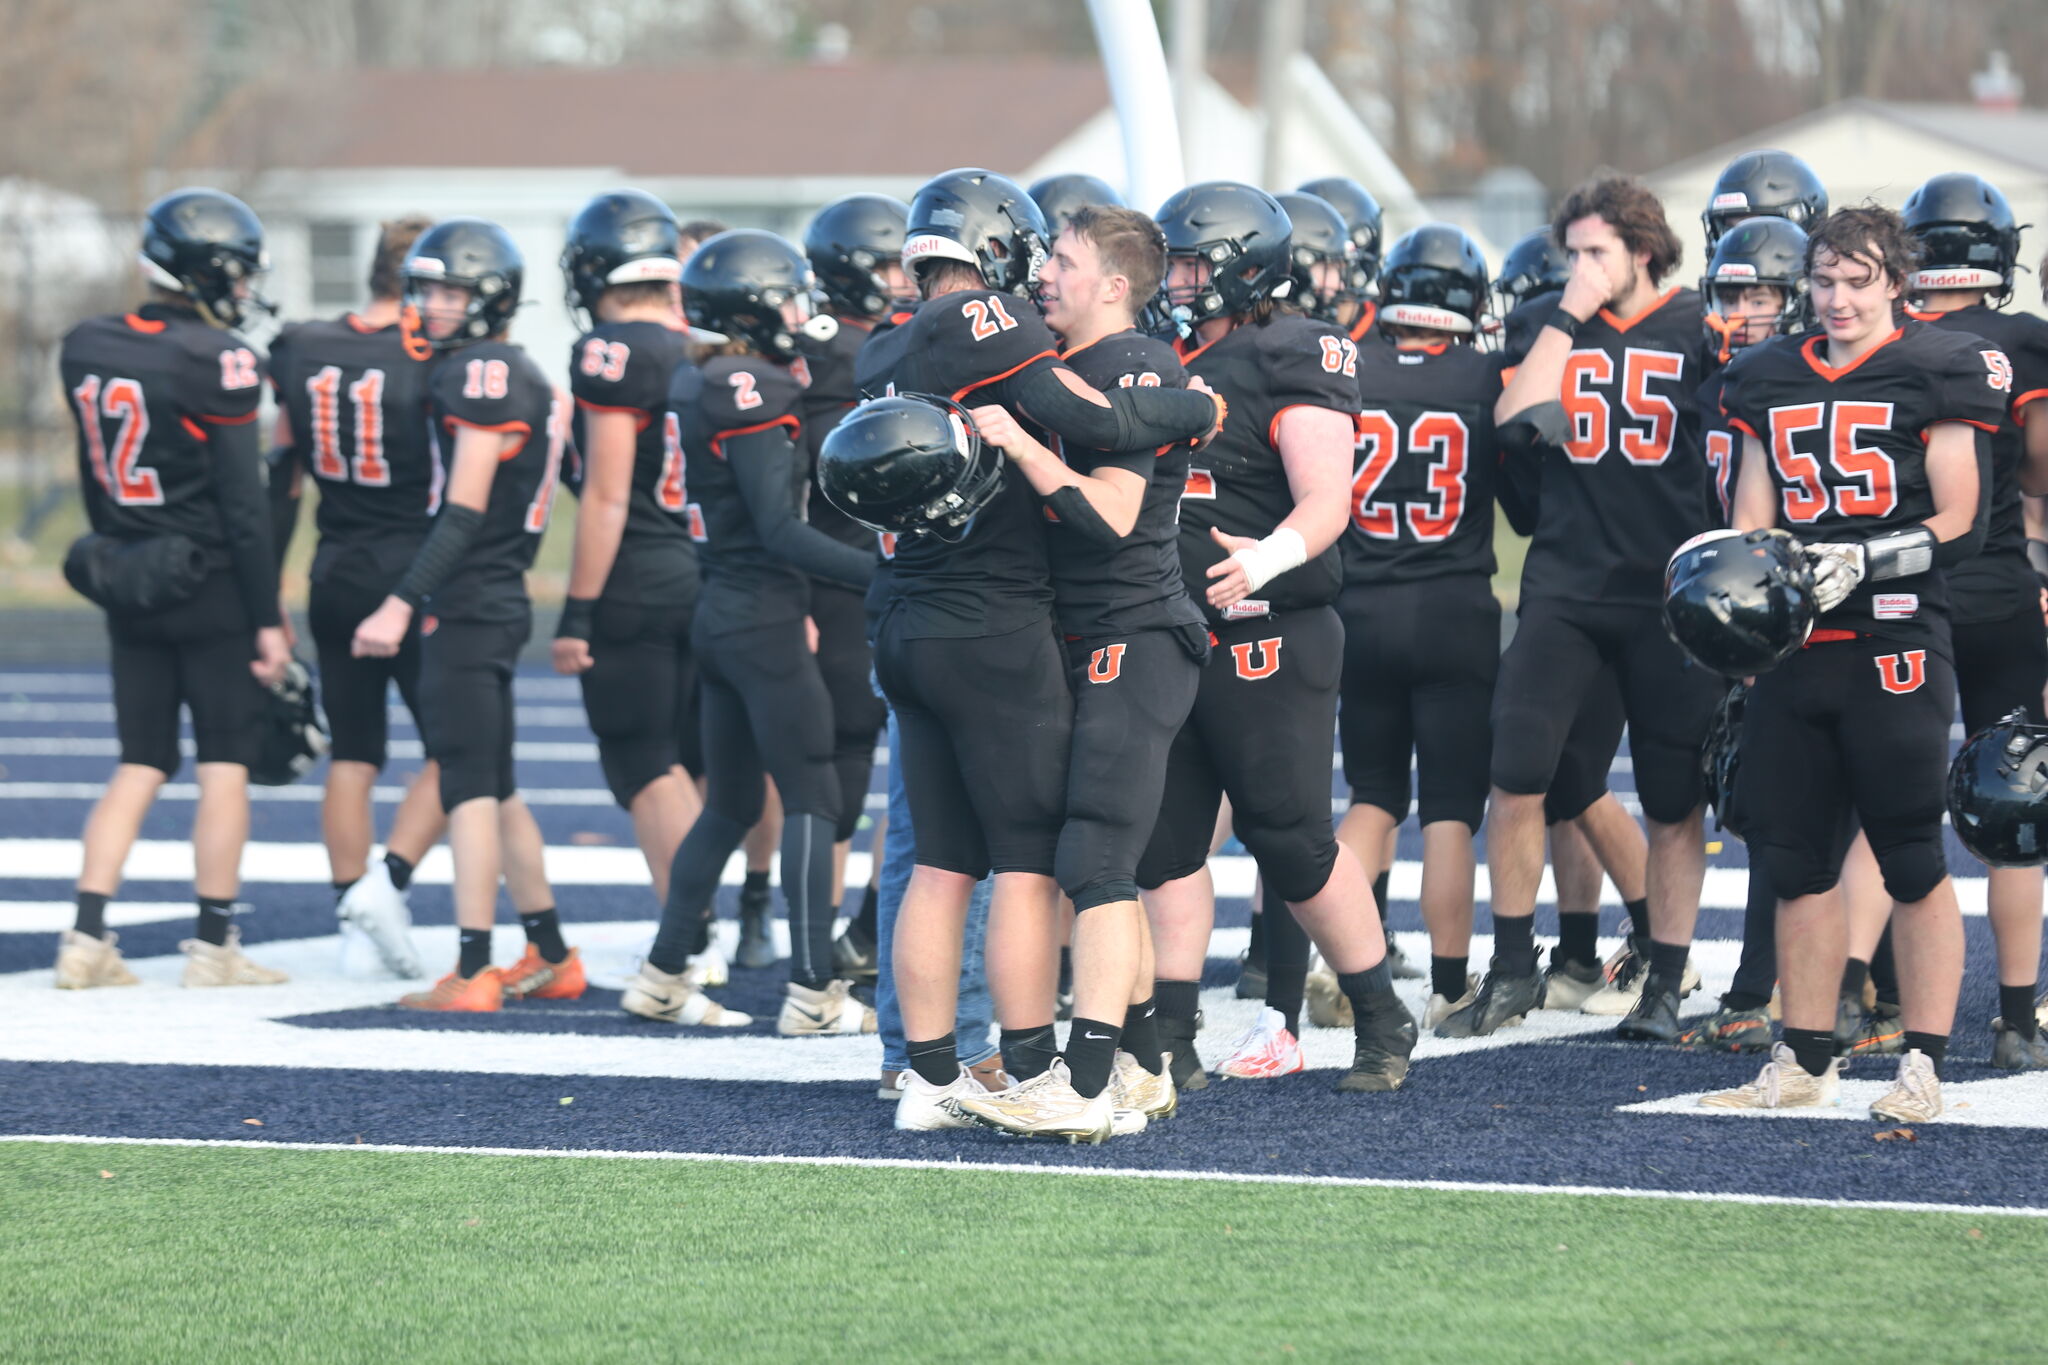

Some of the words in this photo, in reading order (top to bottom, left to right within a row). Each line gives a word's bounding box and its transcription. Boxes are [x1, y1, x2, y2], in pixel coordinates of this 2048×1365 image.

[1918, 273, 1981, 287] Riddell
[962, 295, 1018, 341] 21
[580, 337, 631, 382] 63
[1318, 335, 1357, 378] 62
[728, 371, 764, 410] 2
[1559, 347, 1685, 465] 65
[73, 373, 165, 505] 12
[306, 365, 391, 487] 11
[1351, 409, 1469, 542] 23
[1768, 401, 1898, 523] 55
[1088, 643, 1127, 684] U
[1231, 636, 1283, 681] U
[1873, 649, 1926, 695] U
